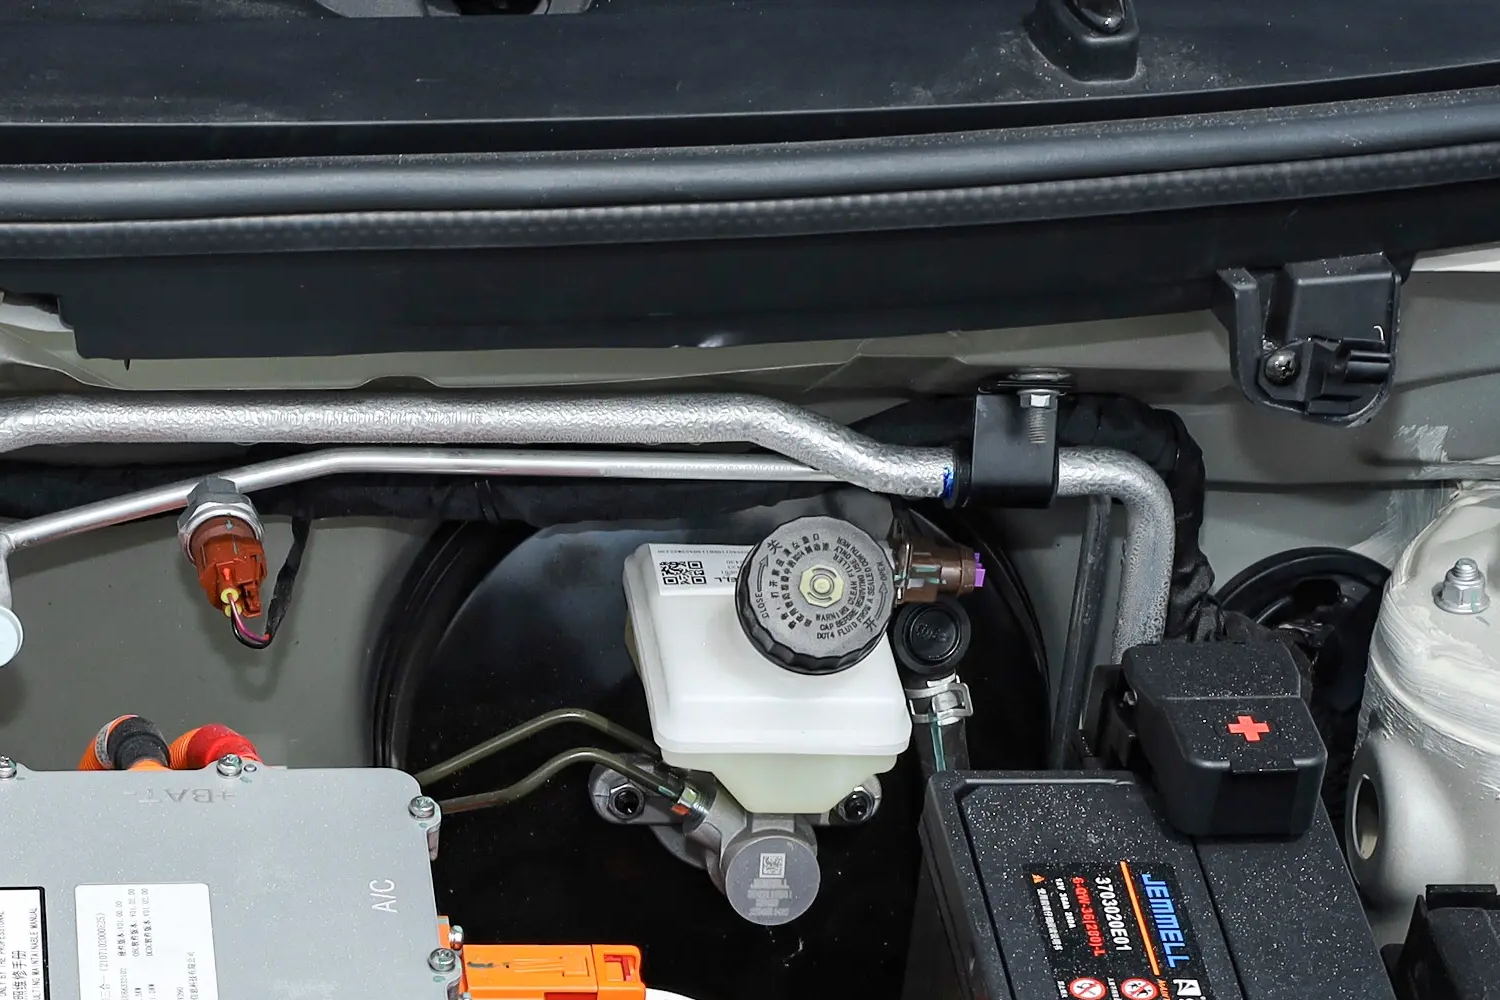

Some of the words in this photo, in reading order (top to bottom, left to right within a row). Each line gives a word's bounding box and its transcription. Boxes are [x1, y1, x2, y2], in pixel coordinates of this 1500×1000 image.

[754, 592, 770, 619] CLOSE
[815, 606, 850, 622] WARNING
[816, 632, 835, 640] DOT4
[819, 622, 834, 631] CAP
[368, 878, 399, 914] A/C
[1094, 876, 1132, 951] 3703020E01
[1139, 873, 1190, 969] JEMMELL
